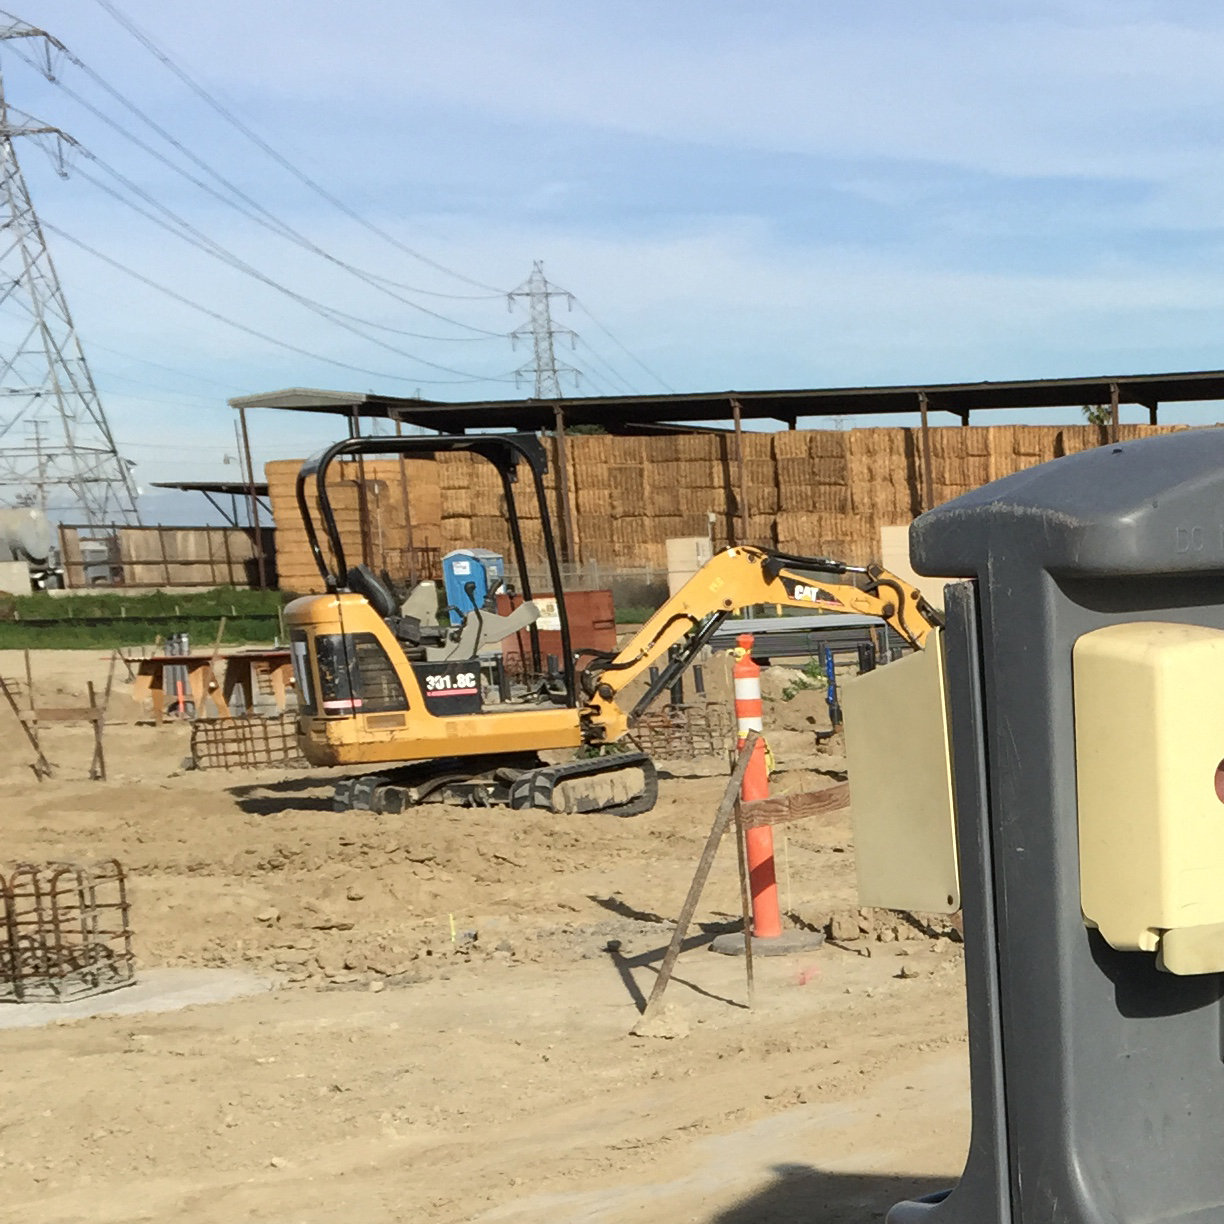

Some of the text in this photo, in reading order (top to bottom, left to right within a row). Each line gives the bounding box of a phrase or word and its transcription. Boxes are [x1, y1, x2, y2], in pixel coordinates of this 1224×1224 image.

[1175, 525, 1204, 553] DO
[794, 584, 819, 602] CAT
[425, 672, 477, 691] 301.8C
